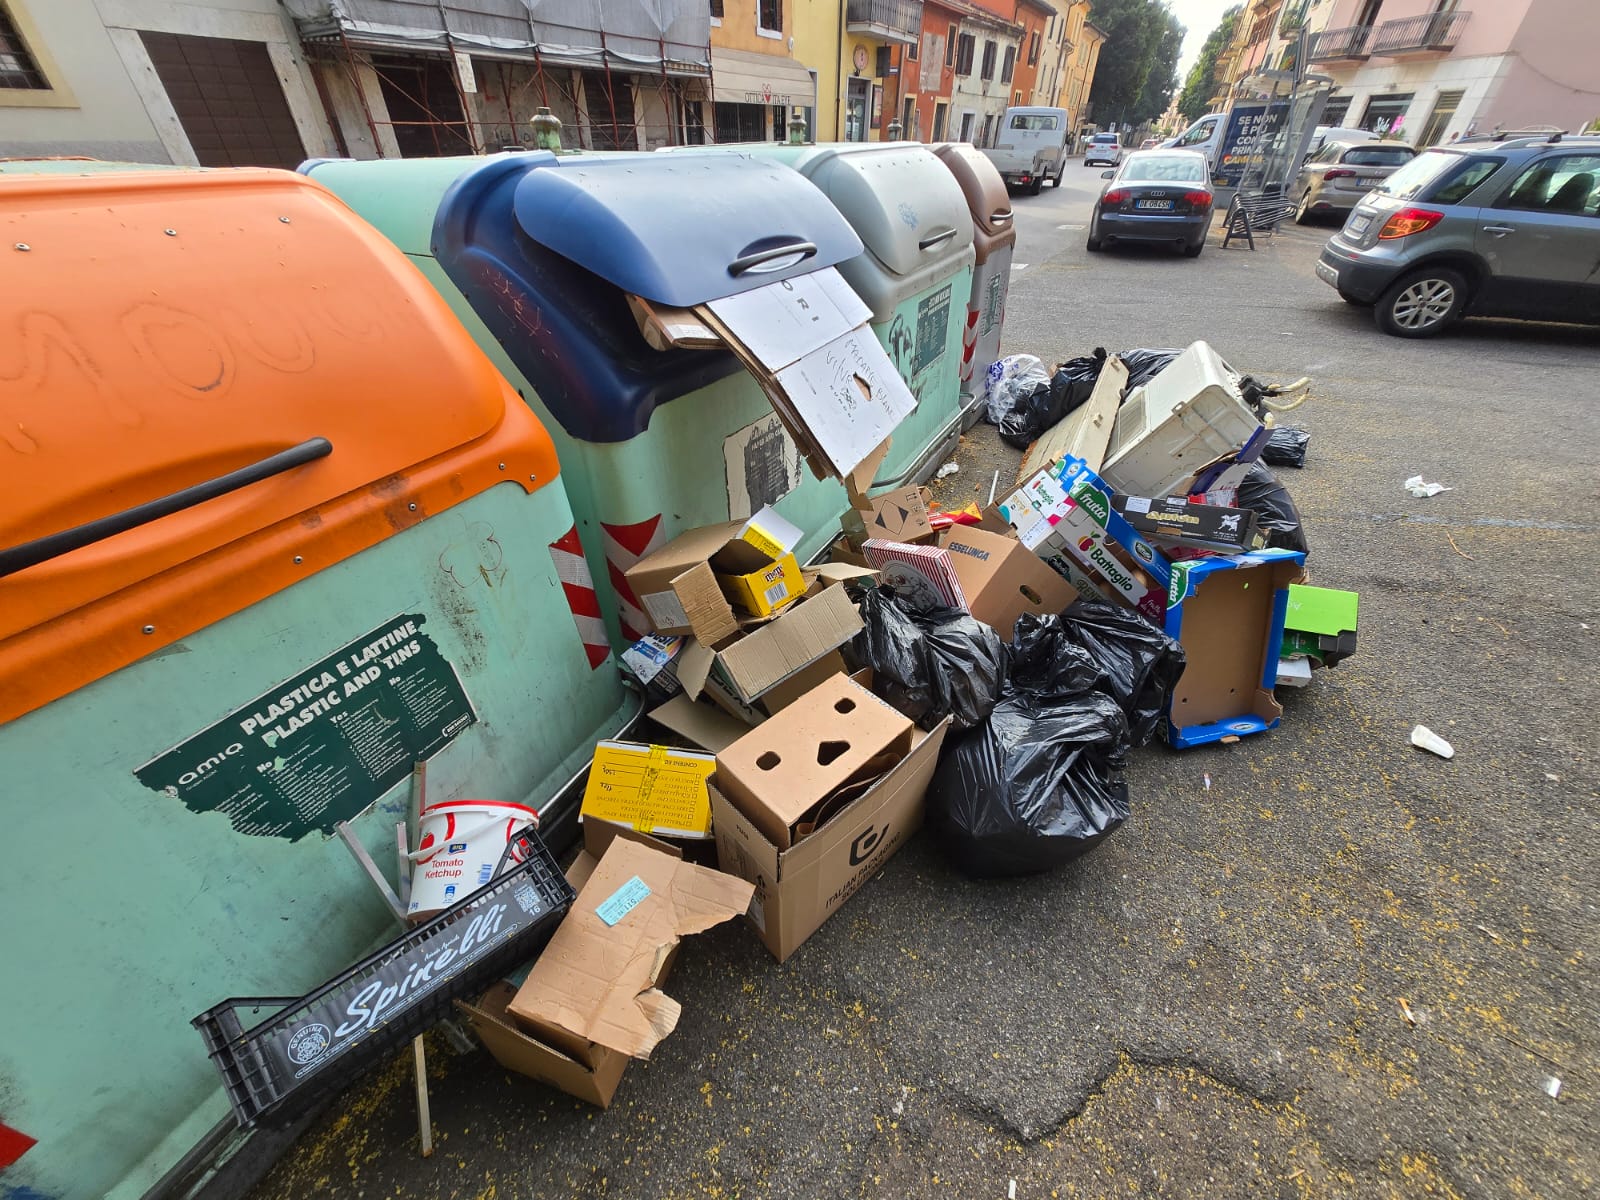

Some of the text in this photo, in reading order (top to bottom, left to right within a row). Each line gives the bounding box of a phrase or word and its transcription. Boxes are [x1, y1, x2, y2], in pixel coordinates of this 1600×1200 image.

[1238, 115, 1253, 125] SE
[1079, 493, 1107, 520] frutta
[948, 541, 989, 562] ESSELUNGA
[1090, 547, 1134, 591] Battaglio
[1169, 568, 1182, 602] frutta
[239, 619, 419, 736] PLASTICA E LATTINE
[388, 674, 402, 687] No
[261, 692, 342, 749] PLASTIC
[345, 665, 382, 700] AND
[382, 639, 422, 671] TINS
[329, 709, 350, 724] Yes
[178, 739, 245, 787] amia
[256, 760, 273, 774] No
[424, 869, 462, 880] Ketchup
[431, 858, 464, 868] Tomato
[825, 831, 901, 909] ITALIAN PACKAGING
[528, 905, 541, 916] 16
[335, 903, 507, 1040] Spinelli
[290, 1026, 323, 1049] GENUINA
